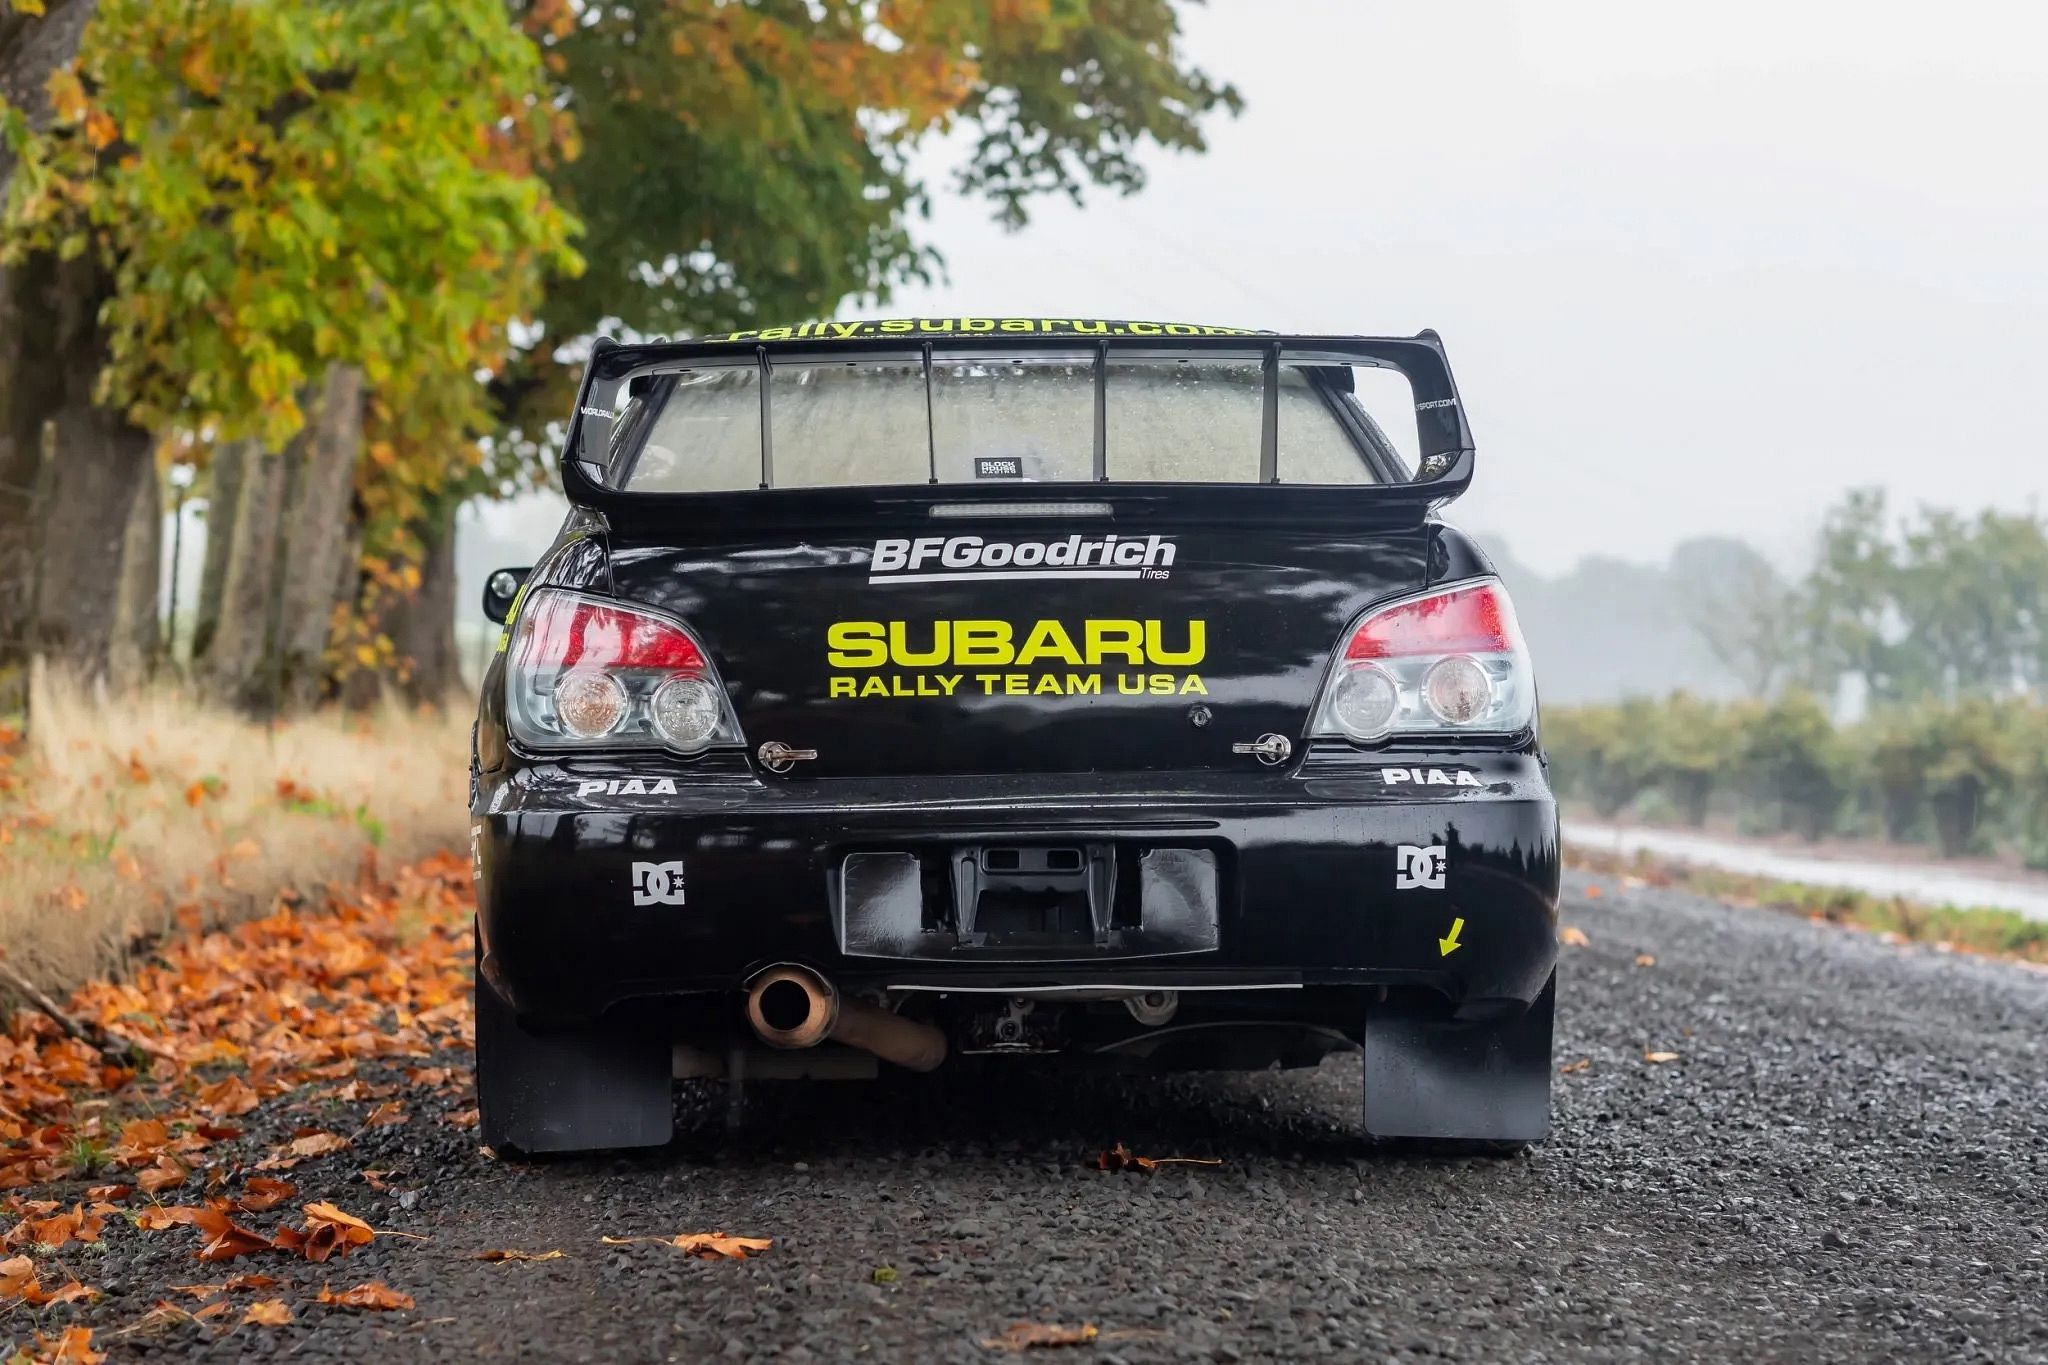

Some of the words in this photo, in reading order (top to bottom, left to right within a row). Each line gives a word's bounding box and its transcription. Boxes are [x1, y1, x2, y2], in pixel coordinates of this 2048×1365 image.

[870, 534, 1177, 571] BFGoodrich
[1140, 567, 1170, 580] Tires
[828, 619, 1206, 668] SUBARU
[830, 674, 964, 698] RALLY
[975, 673, 1102, 697] TEAM
[1117, 673, 1209, 697] USA
[576, 778, 678, 798] PIAA
[1381, 768, 1484, 787] PIAA
